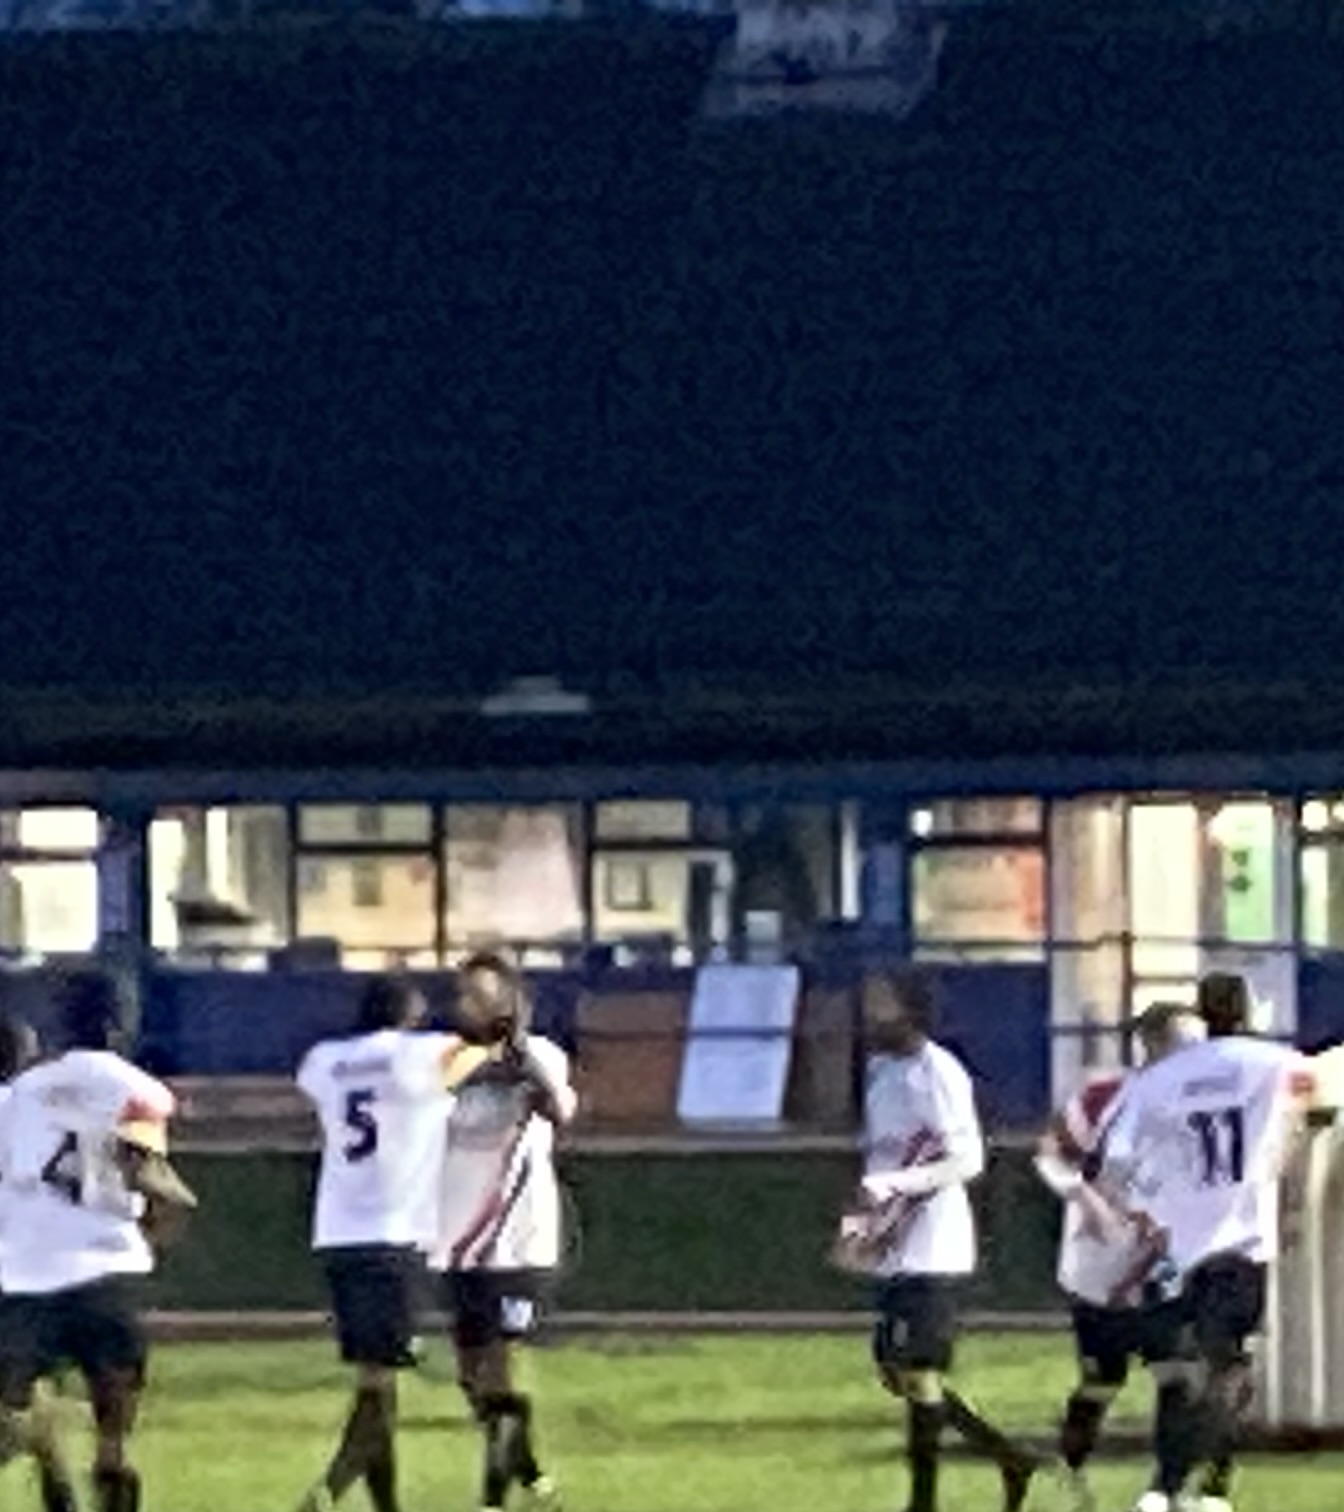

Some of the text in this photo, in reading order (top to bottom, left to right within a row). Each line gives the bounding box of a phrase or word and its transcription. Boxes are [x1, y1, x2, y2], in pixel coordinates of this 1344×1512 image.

[343, 1088, 378, 1164] 5
[1187, 1107, 1244, 1186] 11
[41, 1131, 82, 1205] 4
